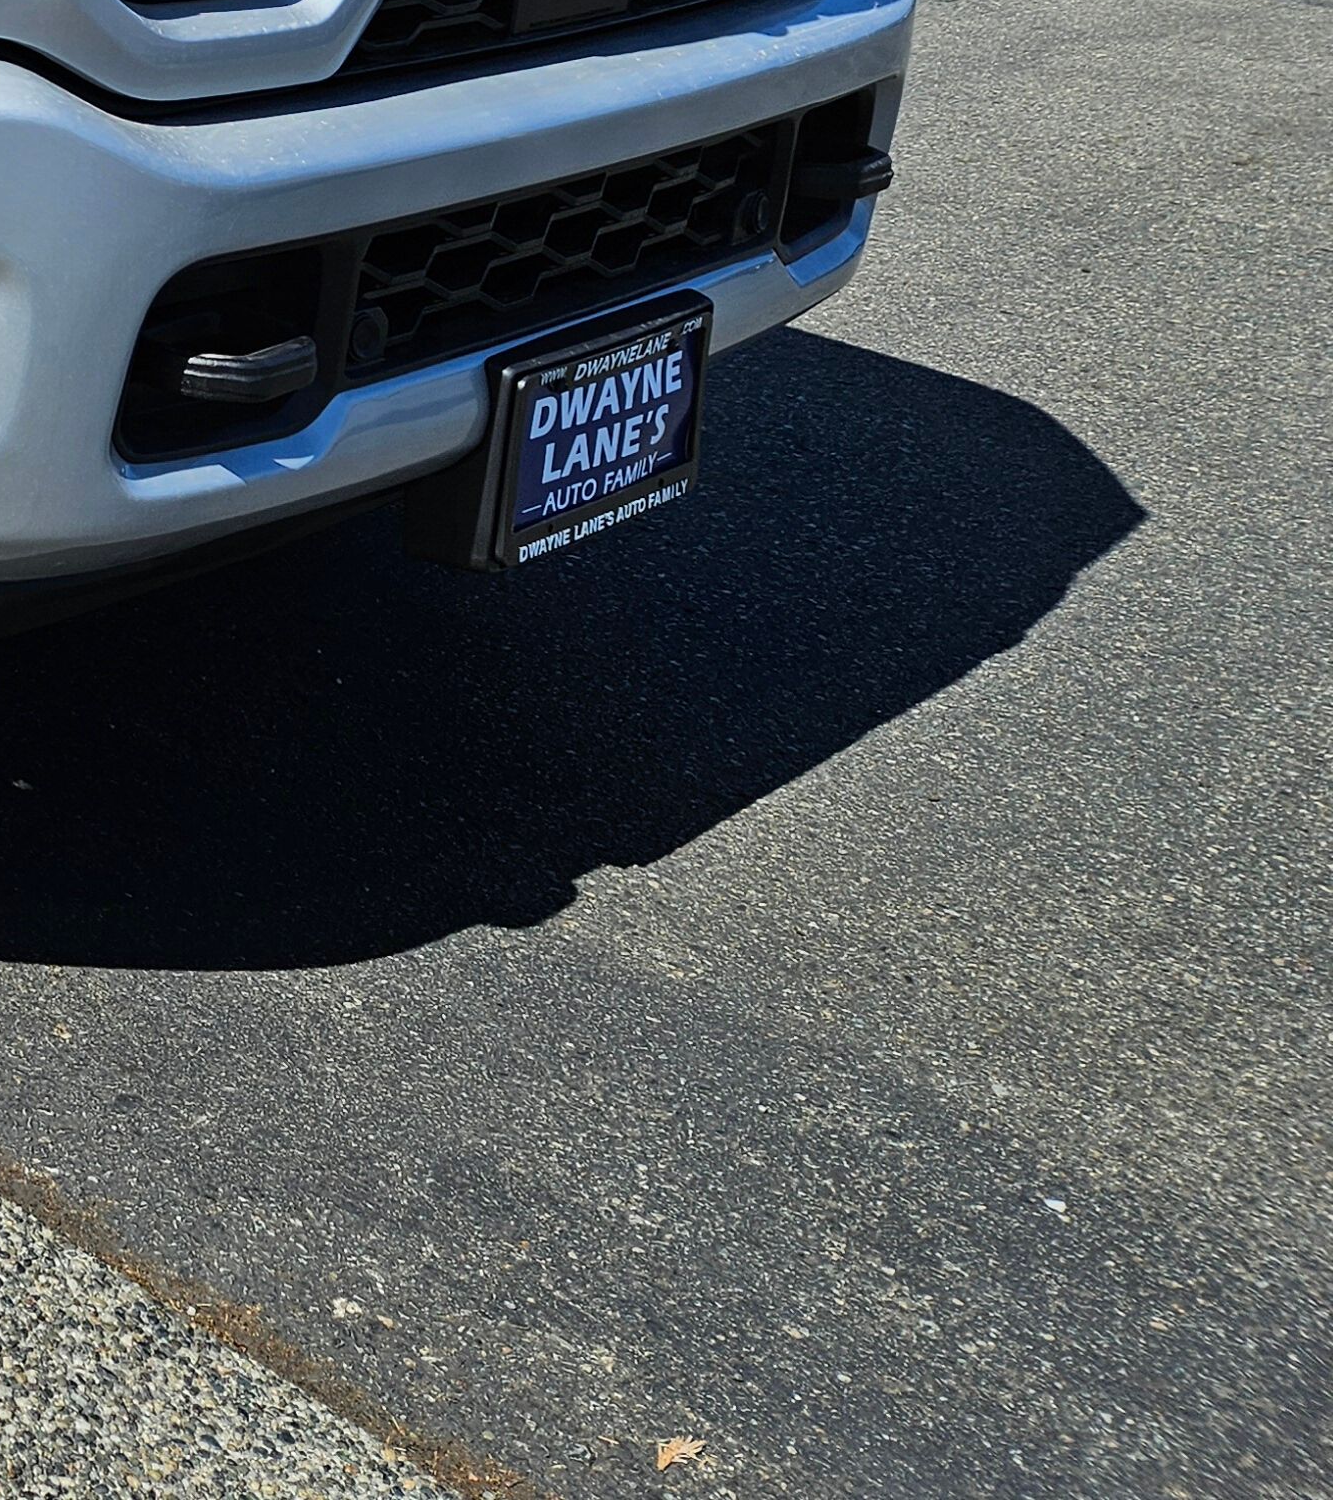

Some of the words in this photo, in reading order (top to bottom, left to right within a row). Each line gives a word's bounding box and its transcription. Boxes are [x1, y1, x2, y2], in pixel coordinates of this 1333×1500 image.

[529, 350, 683, 439] DWAYNE
[574, 332, 672, 381] DWAYNELANE
[542, 404, 669, 484] LANE'S
[542, 478, 597, 516] AUTO
[603, 451, 659, 495] FAMILY
[519, 528, 572, 563] DWAYNE
[574, 510, 616, 541] LANE'S
[616, 497, 647, 523] AUTO
[648, 479, 690, 509] FAMILY
